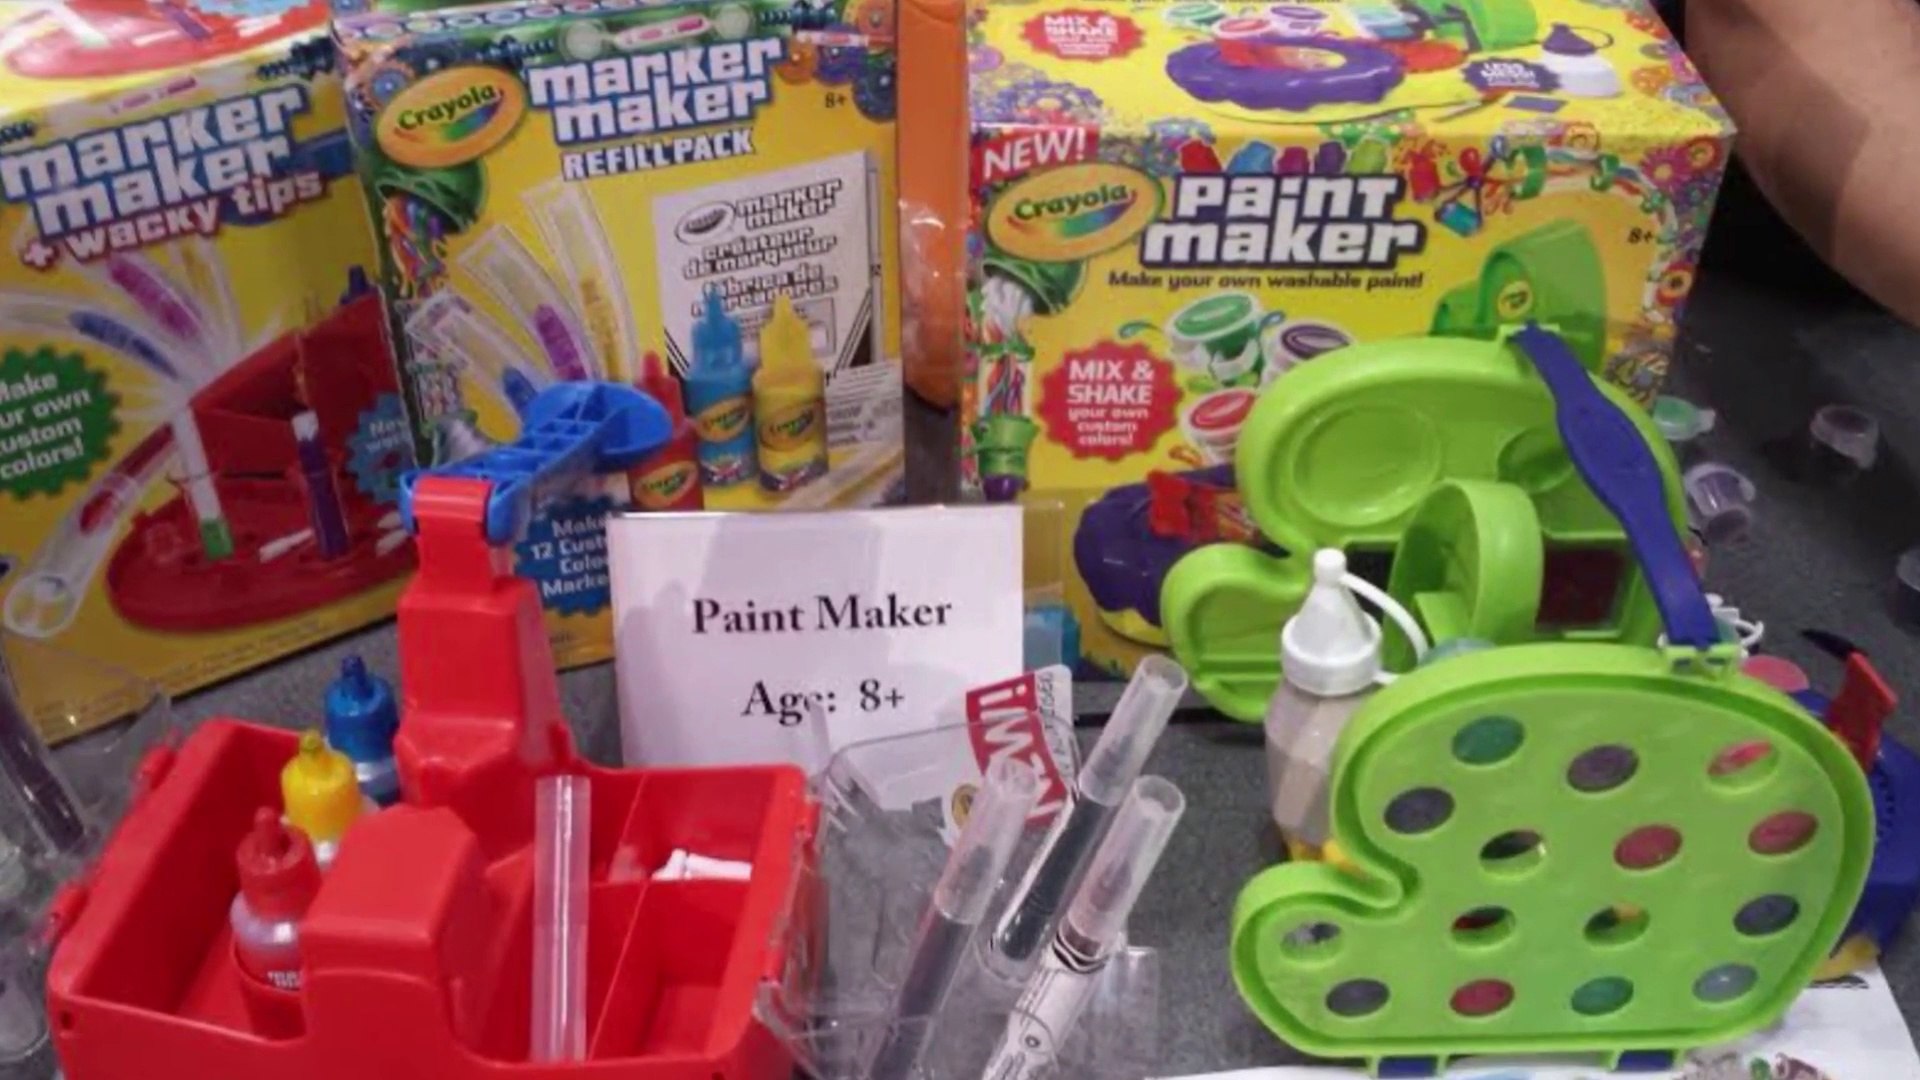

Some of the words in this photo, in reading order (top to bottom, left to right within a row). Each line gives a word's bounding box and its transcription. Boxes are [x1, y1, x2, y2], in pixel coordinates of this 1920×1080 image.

[529, 36, 783, 106] marker
[397, 84, 497, 131] Crayola
[554, 78, 768, 142] maker
[1, 86, 304, 198] marker
[982, 127, 1088, 180] NEW!
[33, 134, 291, 236] maker
[1014, 184, 1128, 220] Crayola
[64, 198, 219, 263] wacky
[232, 171, 325, 215] tips
[1143, 198, 1419, 264] maker
[1628, 227, 1654, 245] 8+
[1108, 270, 1163, 287] Make
[1168, 275, 1212, 291] your
[1218, 274, 1262, 288] own
[1268, 270, 1362, 288] washable
[1366, 272, 1424, 291] paint!
[1069, 360, 1124, 381] MIX
[1131, 360, 1155, 381] &
[33, 389, 92, 418] own
[1066, 384, 1153, 405] SHAKE
[1068, 407, 1107, 422] your
[1111, 407, 1149, 420] own
[1077, 421, 1138, 433] custom
[0, 418, 83, 457] ustom
[0, 435, 84, 478] colors!
[531, 542, 554, 560] 12
[692, 598, 804, 634] Paint
[814, 593, 953, 630] Maker
[859, 678, 905, 712] 8+
